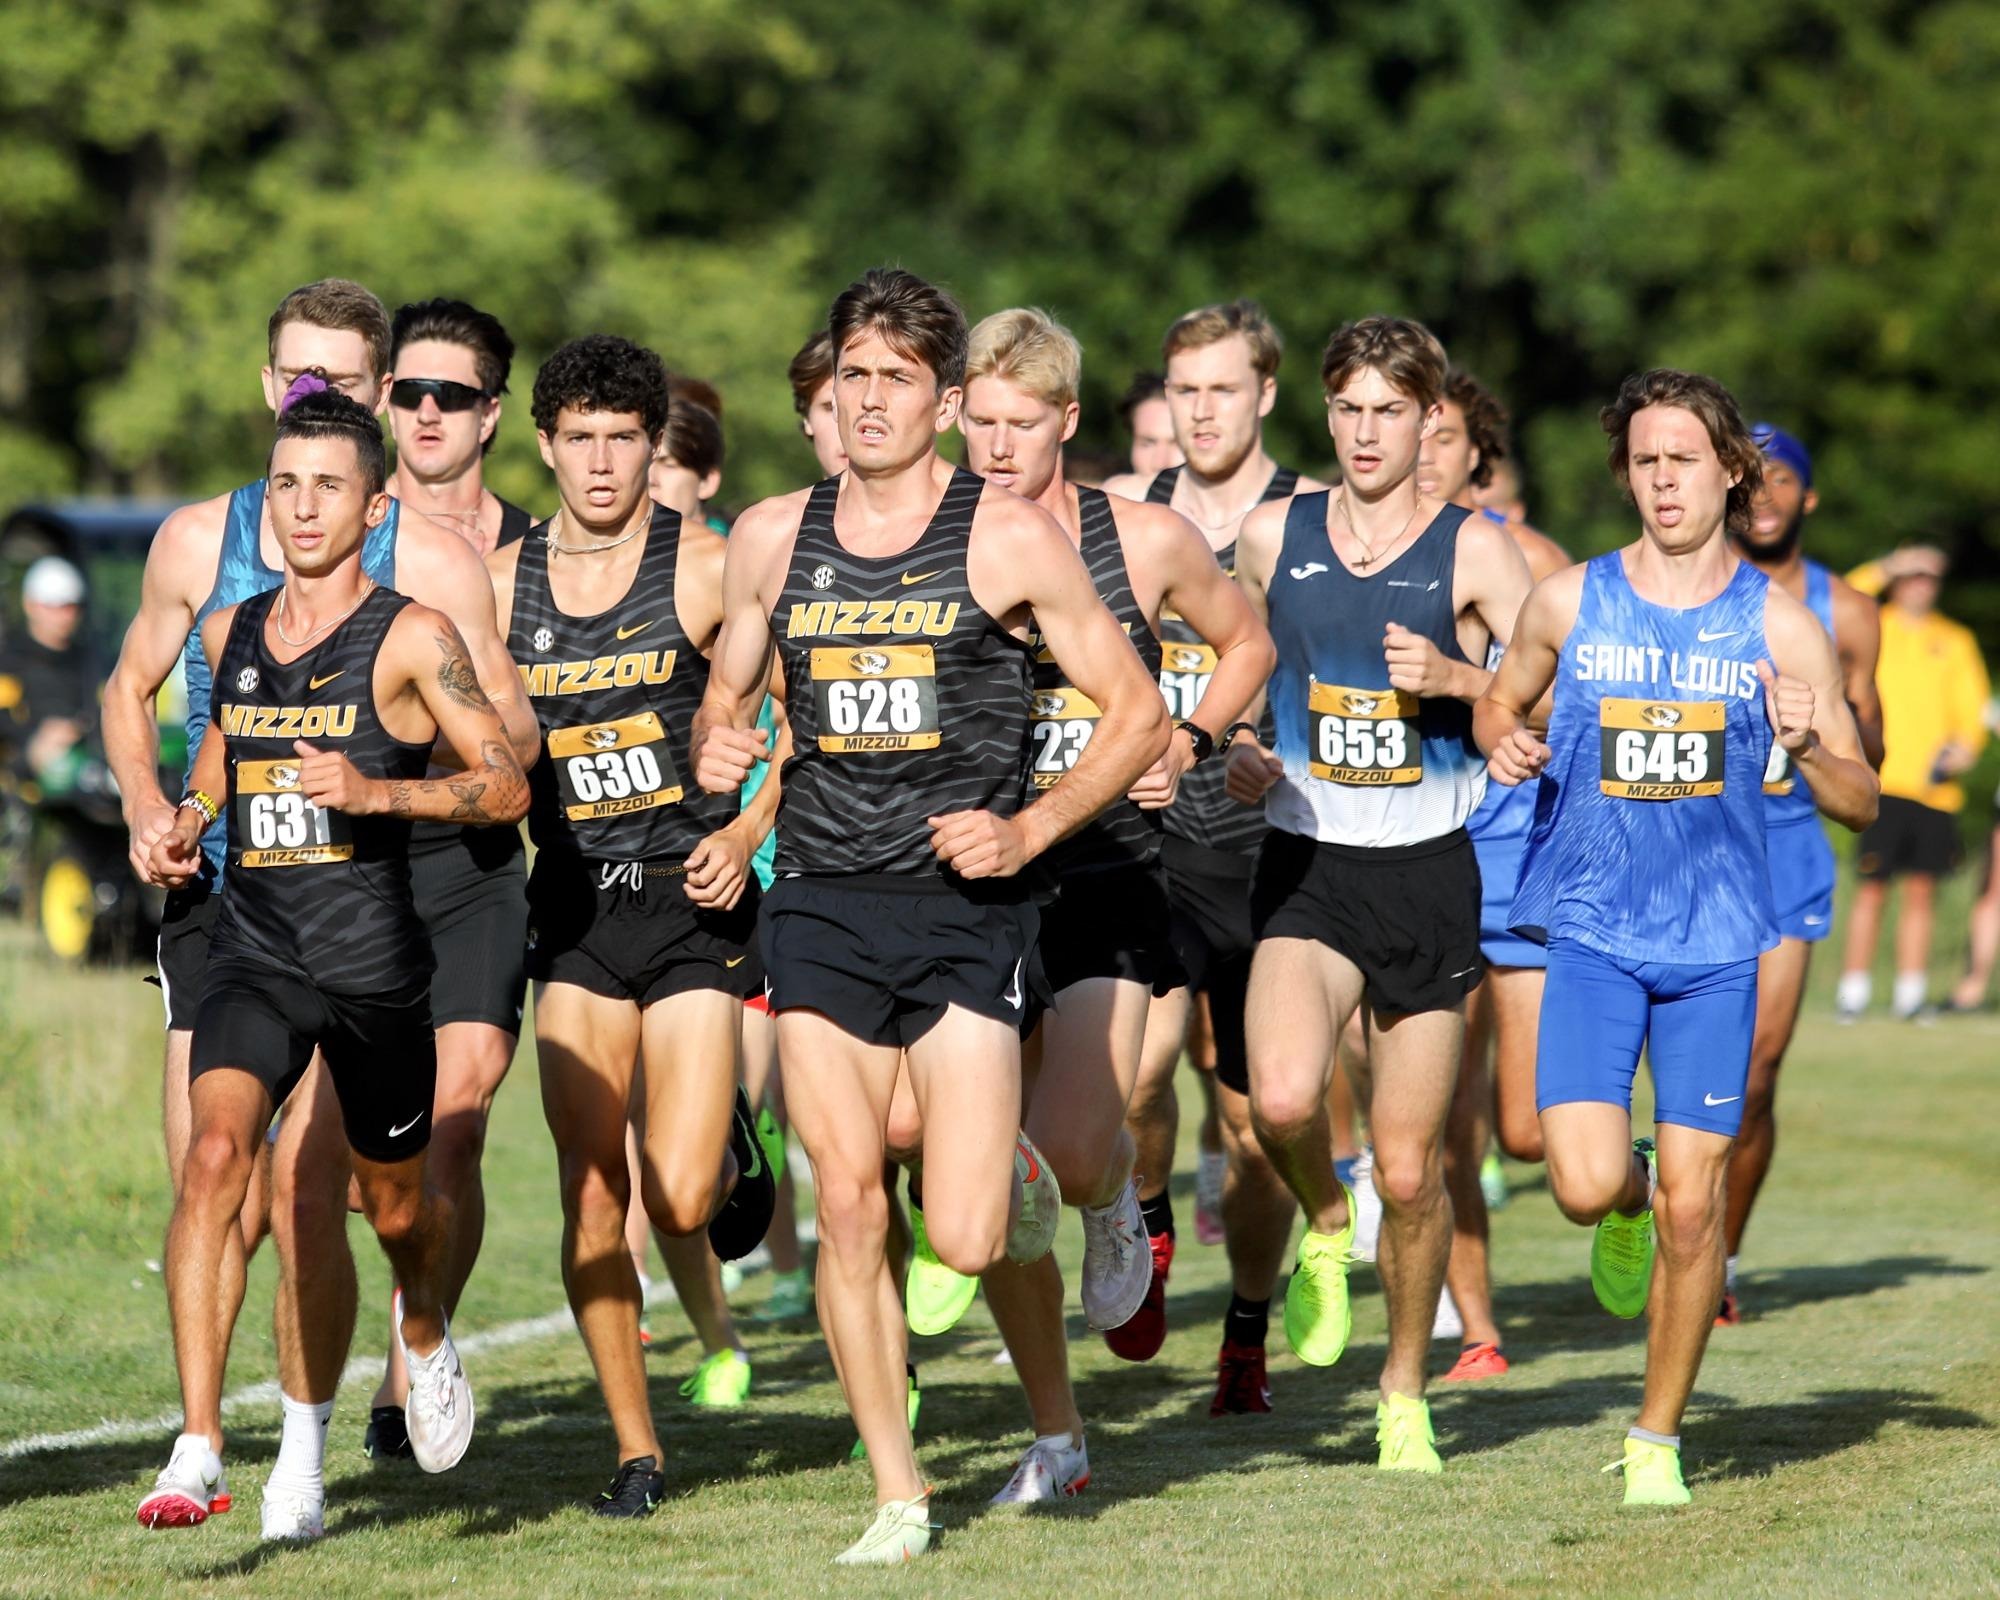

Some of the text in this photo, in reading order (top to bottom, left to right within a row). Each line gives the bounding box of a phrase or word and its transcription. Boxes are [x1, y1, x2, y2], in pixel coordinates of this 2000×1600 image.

[787, 600, 961, 639] MIZZOU
[517, 650, 677, 697] MIZZOU
[1576, 644, 1759, 700] SAINT LOUIS
[220, 704, 357, 738] MIZZOU
[828, 679, 921, 735] 628
[843, 736, 910, 750] MIZZOU
[1033, 720, 1094, 771] 23
[1318, 715, 1406, 769] 653
[1615, 730, 1708, 783] 643
[567, 746, 662, 803] 630
[1329, 768, 1394, 782] MIZZOU
[1626, 784, 1696, 798] MIZZOU
[250, 793, 331, 849] 631
[593, 795, 655, 817] MIZZOU
[257, 849, 324, 865] MIZZOU
